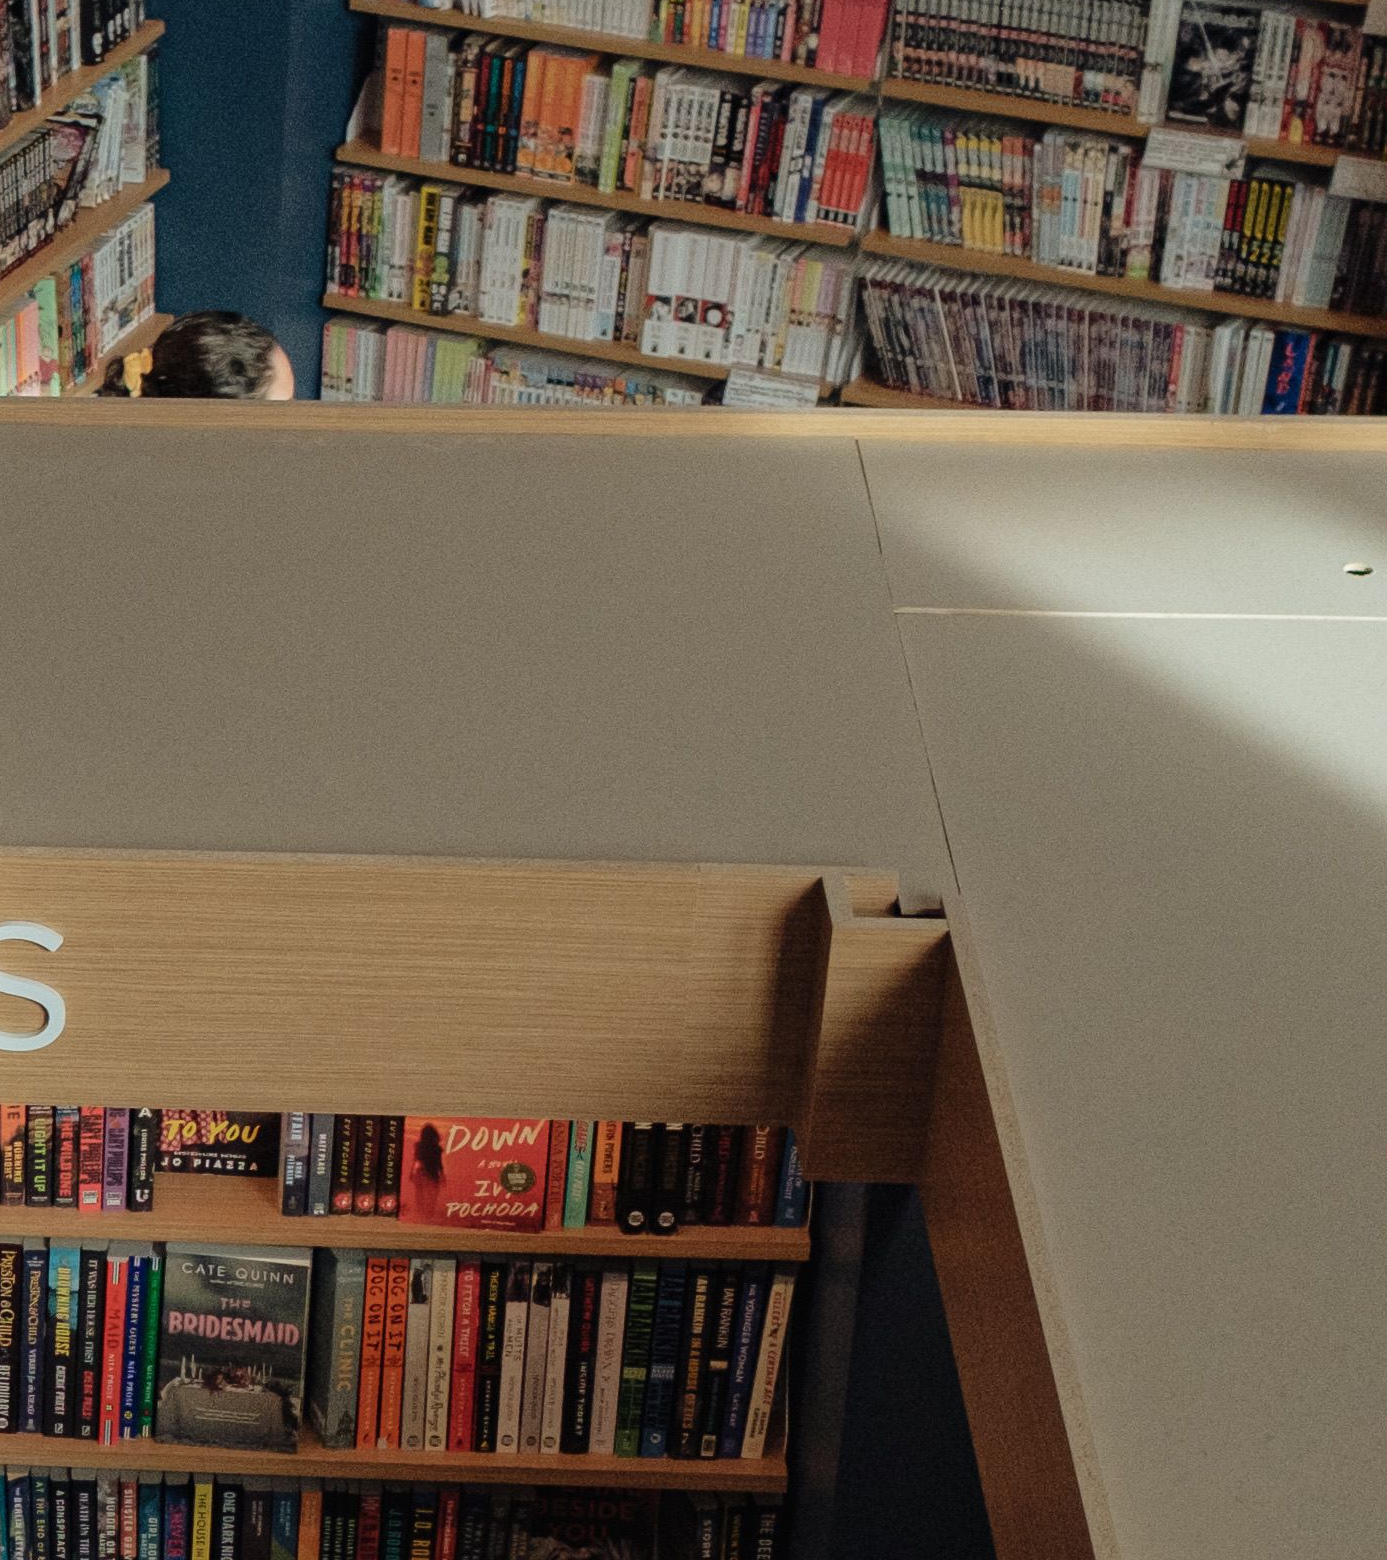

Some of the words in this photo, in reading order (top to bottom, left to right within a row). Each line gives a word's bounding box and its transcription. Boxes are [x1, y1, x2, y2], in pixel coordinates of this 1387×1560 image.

[165, 1119, 197, 1140] TO
[208, 1119, 261, 1145] YOU
[445, 1119, 546, 1155] DOWN
[446, 1201, 539, 1218] POCHODA
[181, 1261, 227, 1277] CATE
[235, 1267, 295, 1285] QUINN
[220, 1297, 251, 1310] THE
[168, 1310, 300, 1347] BRIDESMAID
